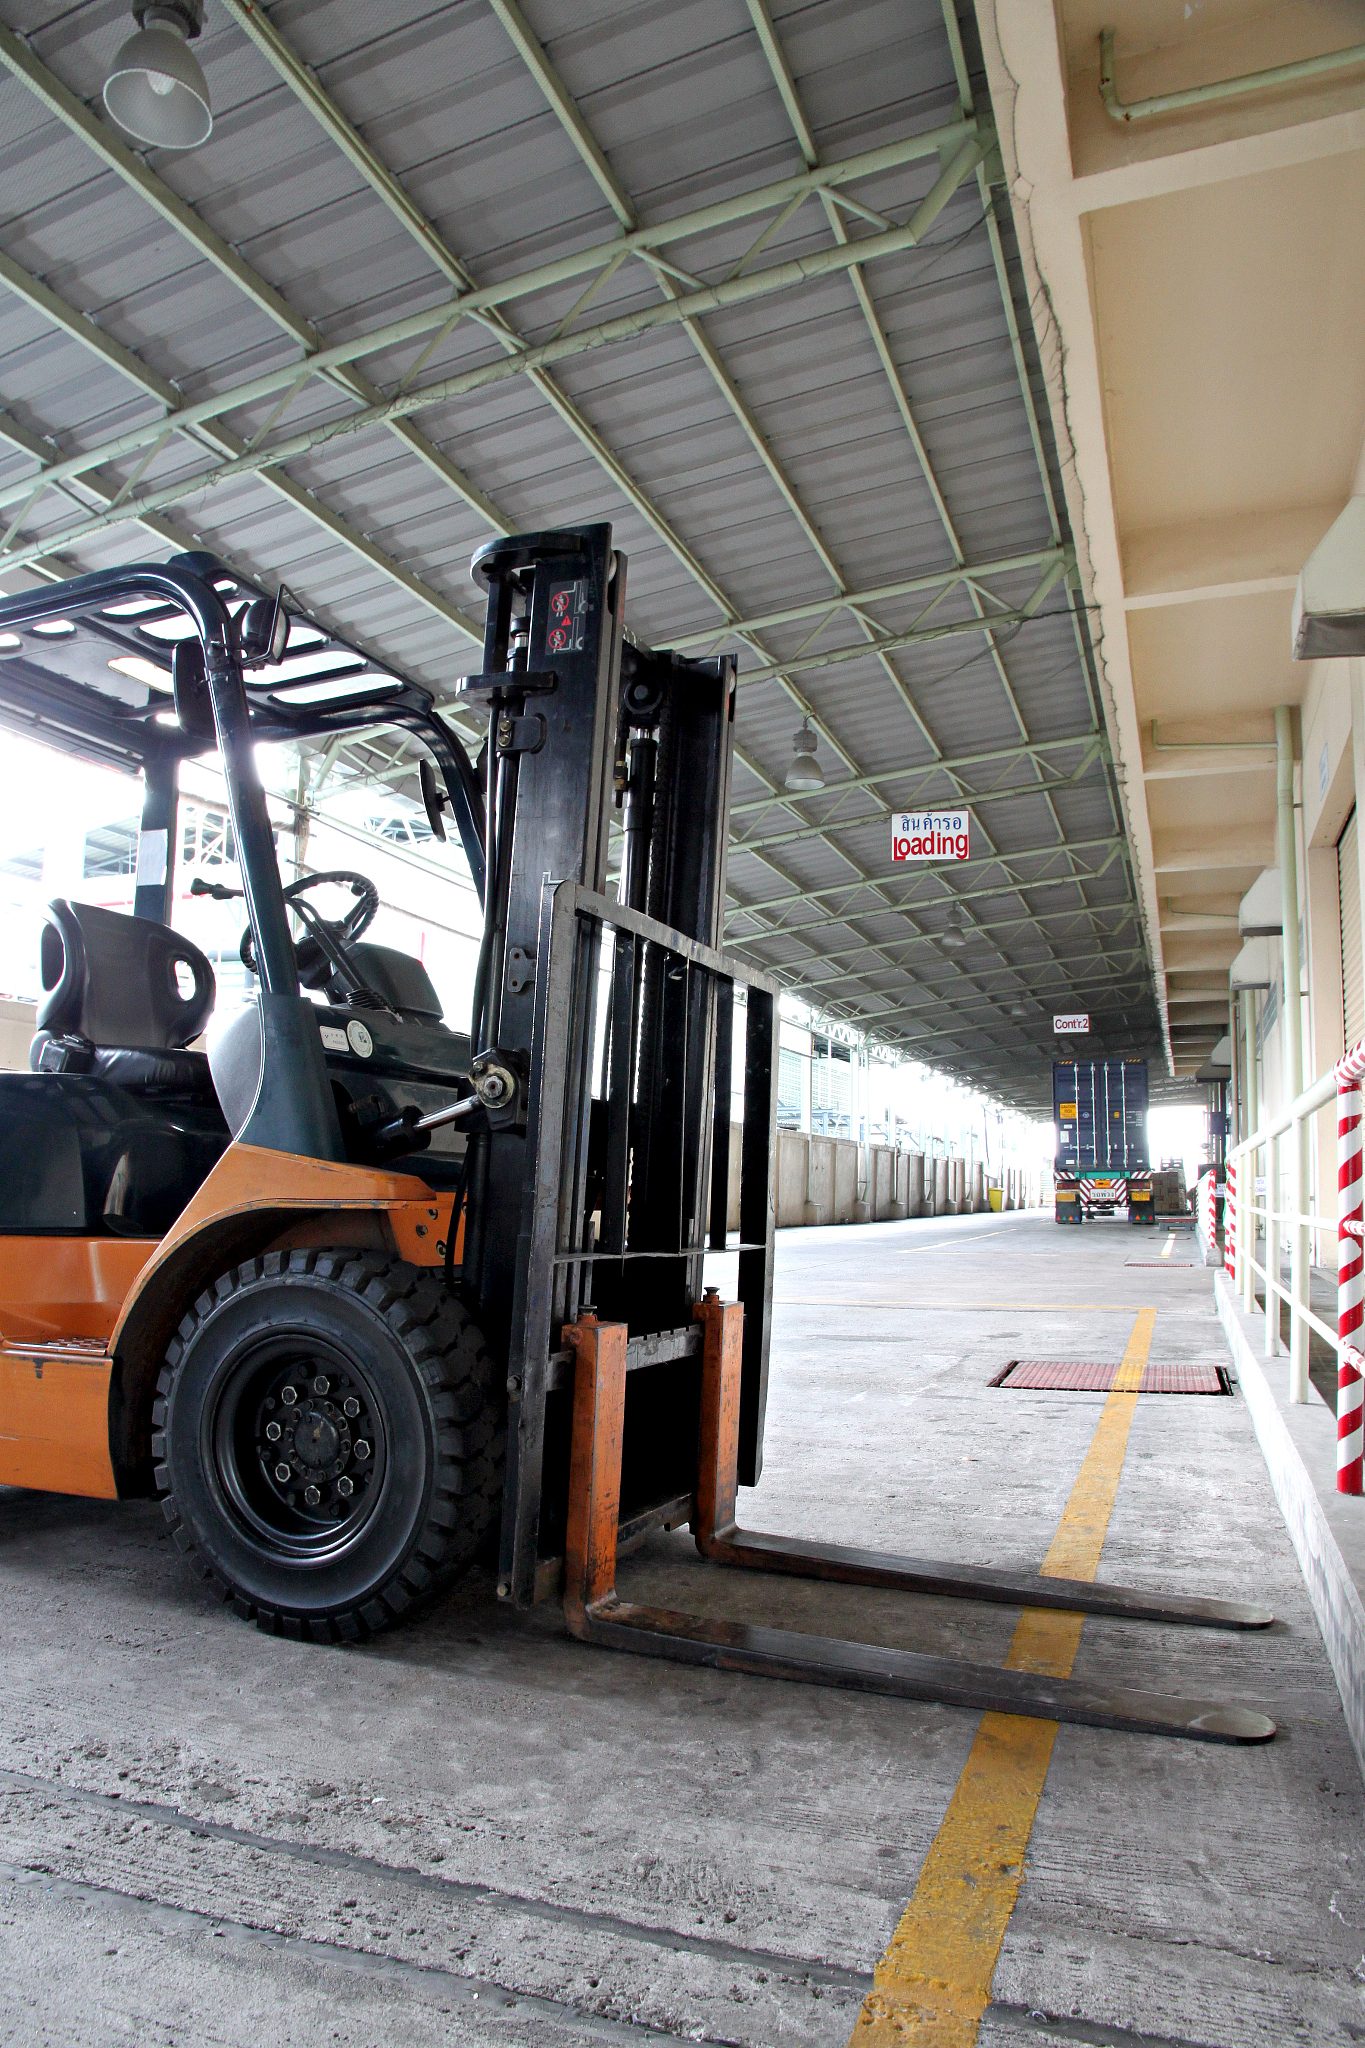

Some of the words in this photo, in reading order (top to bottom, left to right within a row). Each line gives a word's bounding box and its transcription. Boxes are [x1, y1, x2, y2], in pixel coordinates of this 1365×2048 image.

[901, 813, 962, 831] สินค้ารอ
[893, 831, 968, 860] Loading
